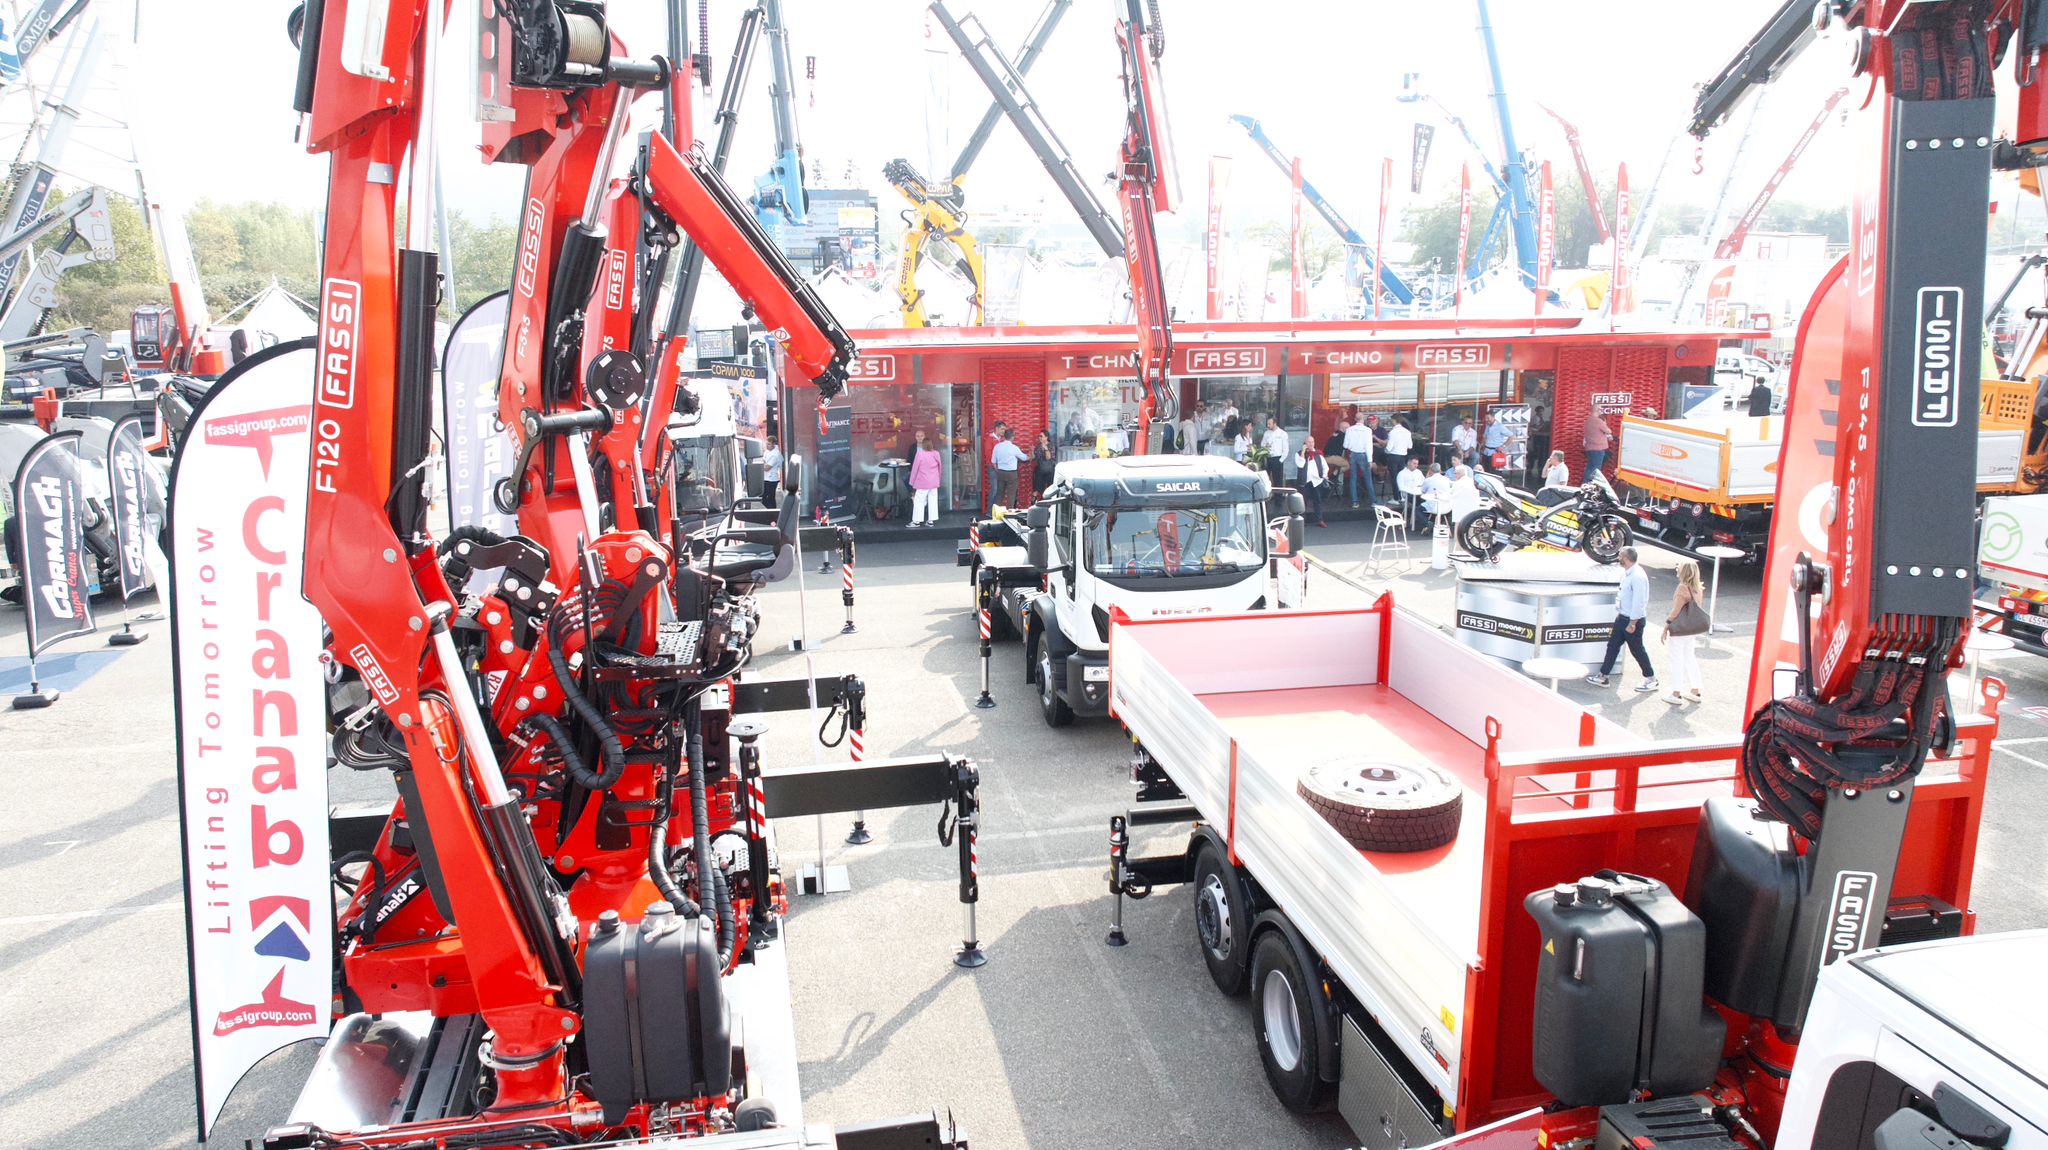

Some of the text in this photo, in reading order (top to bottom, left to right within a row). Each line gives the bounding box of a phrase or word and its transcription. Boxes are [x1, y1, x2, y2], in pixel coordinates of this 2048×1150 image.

[519, 203, 544, 293] FASSI
[609, 254, 624, 305] FASSI
[326, 289, 354, 397] FASSI
[1062, 355, 1134, 369] TECHN
[1193, 352, 1259, 367] FASSI
[1301, 351, 1382, 365] TECHNO
[1422, 349, 1484, 363] FASSI
[1922, 294, 1952, 419] FASSI
[1594, 394, 1629, 405] FASSI
[1856, 366, 1871, 452] F345
[206, 413, 308, 438] fassigroup.com
[455, 381, 471, 494] Tomorrow
[316, 419, 341, 493] F120
[1155, 482, 1201, 493] SAICAR
[1845, 481, 1857, 531] OMC
[30, 476, 74, 620] CORMACH
[1463, 617, 1494, 630] FASSI
[1498, 622, 1526, 635] mooney
[1549, 630, 1581, 642] FASSI
[354, 649, 394, 699] FASSI
[1821, 628, 1846, 681] FASSI
[241, 495, 306, 870] Cranab
[197, 526, 230, 935] Lifting Tomorrow
